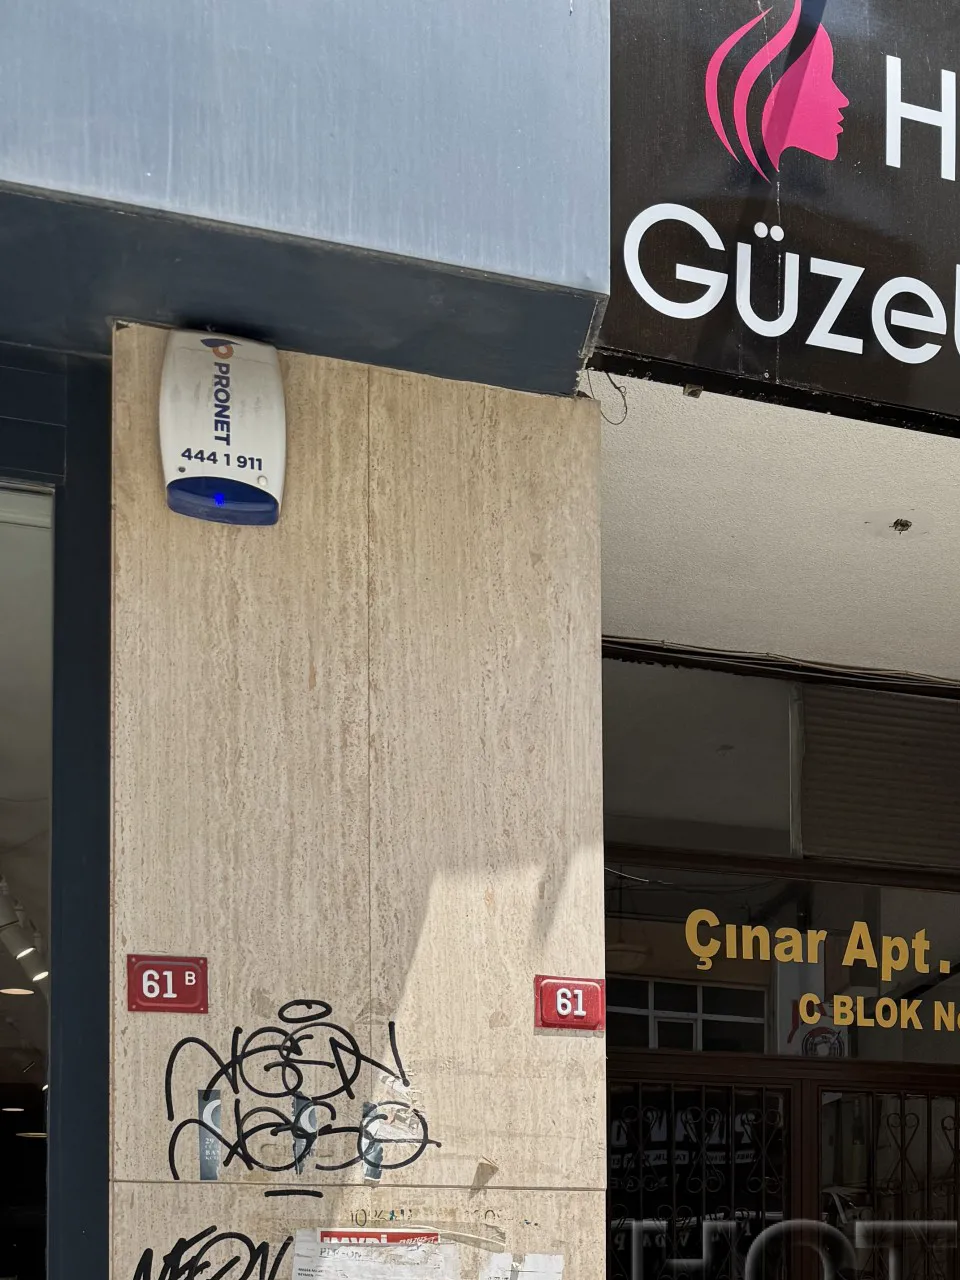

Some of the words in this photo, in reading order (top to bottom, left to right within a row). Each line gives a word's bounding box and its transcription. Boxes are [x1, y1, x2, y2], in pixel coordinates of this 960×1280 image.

[213, 362, 231, 446] PRONET
[181, 447, 218, 465] 444
[224, 453, 231, 466] 1
[236, 455, 263, 471] 911
[685, 908, 828, 970] Çınar
[842, 920, 951, 982] Apt.
[556, 987, 588, 1018] 61
[799, 993, 821, 1025] C
[833, 994, 924, 1030] BLOK
